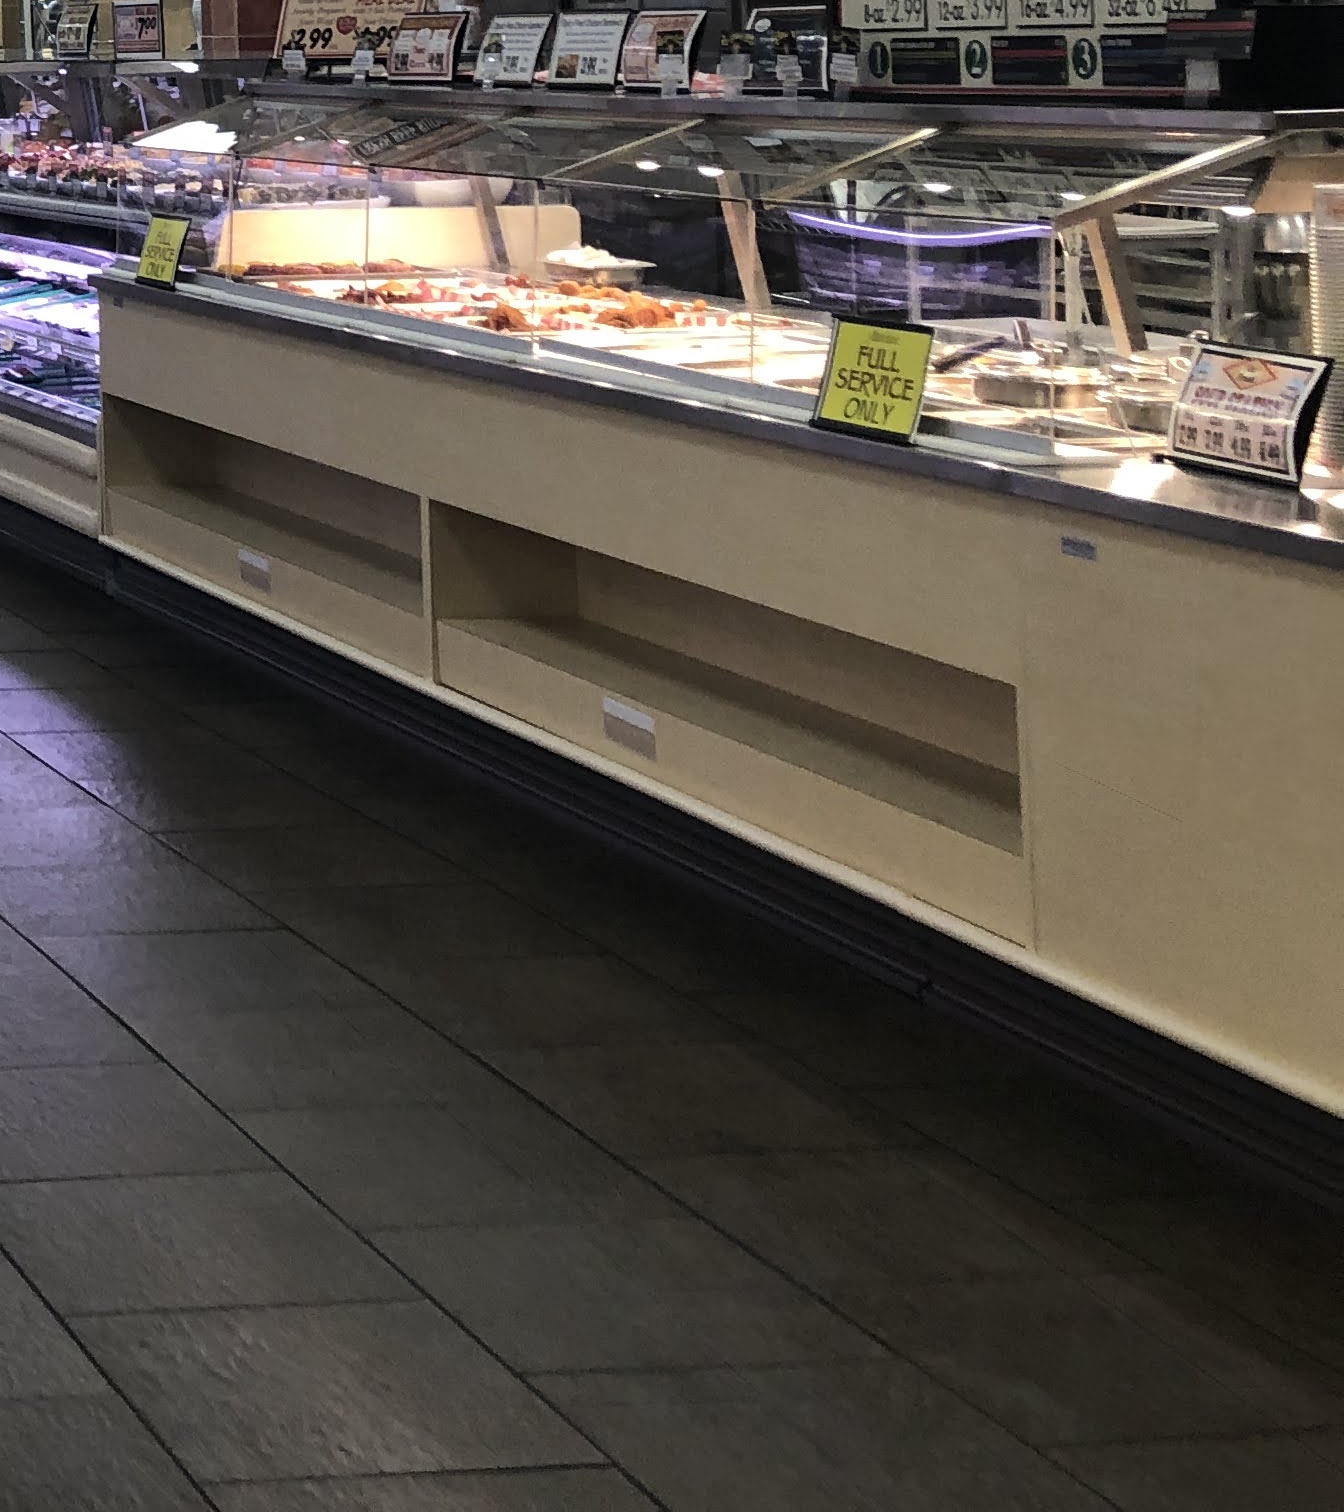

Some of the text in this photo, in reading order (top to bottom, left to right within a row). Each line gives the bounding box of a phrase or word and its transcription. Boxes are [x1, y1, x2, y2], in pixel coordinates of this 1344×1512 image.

[970, 43, 985, 76] 2
[1078, 40, 1095, 76] 3
[857, 345, 900, 373] FULL
[834, 368, 915, 401] SERVICE
[844, 397, 895, 425] ONLY
